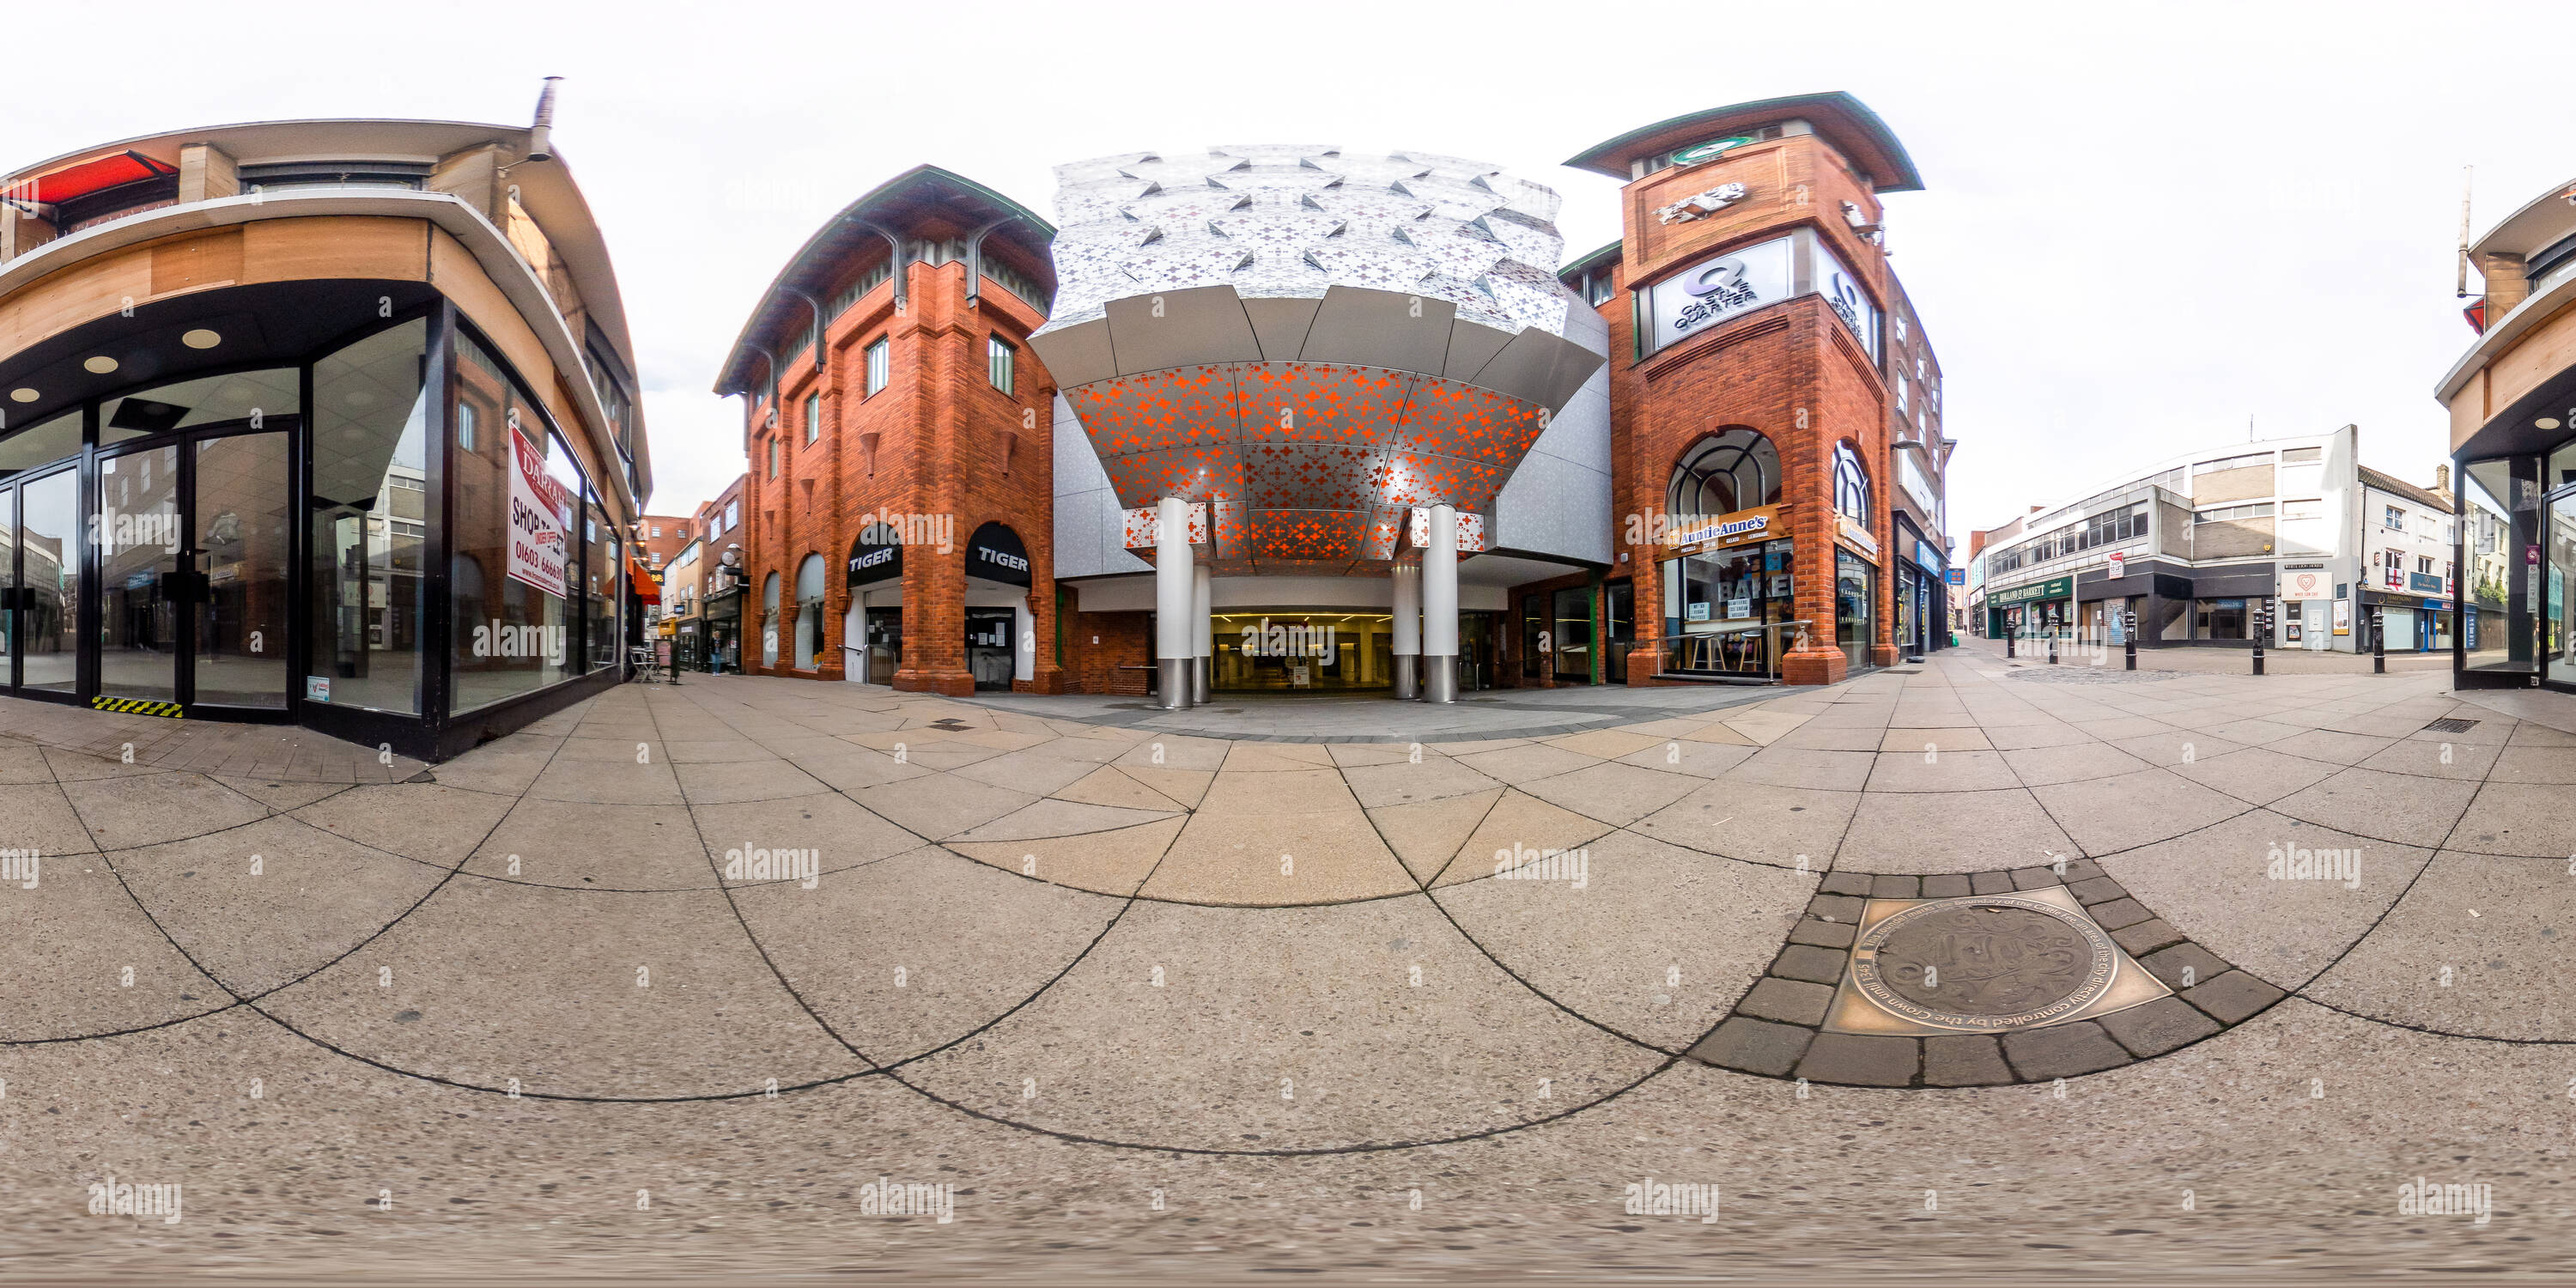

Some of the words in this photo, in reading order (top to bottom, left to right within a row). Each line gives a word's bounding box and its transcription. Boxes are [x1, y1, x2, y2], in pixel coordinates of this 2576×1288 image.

[1681, 282, 1749, 316] CASTLE
[1674, 290, 1759, 328] QUARTER
[522, 451, 565, 512] DARRAH
[516, 540, 538, 568] 01603
[541, 556, 563, 581] 666630
[849, 547, 876, 572] TIGER
[977, 546, 1028, 572] TIGER
[2000, 591, 2018, 603] HOLLAND
[2023, 585, 2044, 598] BARRETT
[1935, 902, 1953, 910] the
[1953, 898, 2004, 908] boundary
[2034, 903, 2061, 916] Castle
[1907, 906, 1935, 919] marks
[1878, 914, 1907, 936] roundel
[2076, 922, 2087, 932] an
[1864, 934, 1880, 946] This
[2086, 929, 2101, 944] area
[2096, 941, 2108, 951] of
[2099, 949, 2111, 963] the
[1856, 963, 1870, 981] 1345
[2093, 961, 2111, 978] city
[1864, 979, 1890, 1001] until
[2070, 977, 2105, 1005] directly
[1887, 998, 1932, 1020] Crown
[1993, 1001, 2071, 1028] controlled
[1935, 1013, 1964, 1025] the
[1965, 1016, 1989, 1028] by
